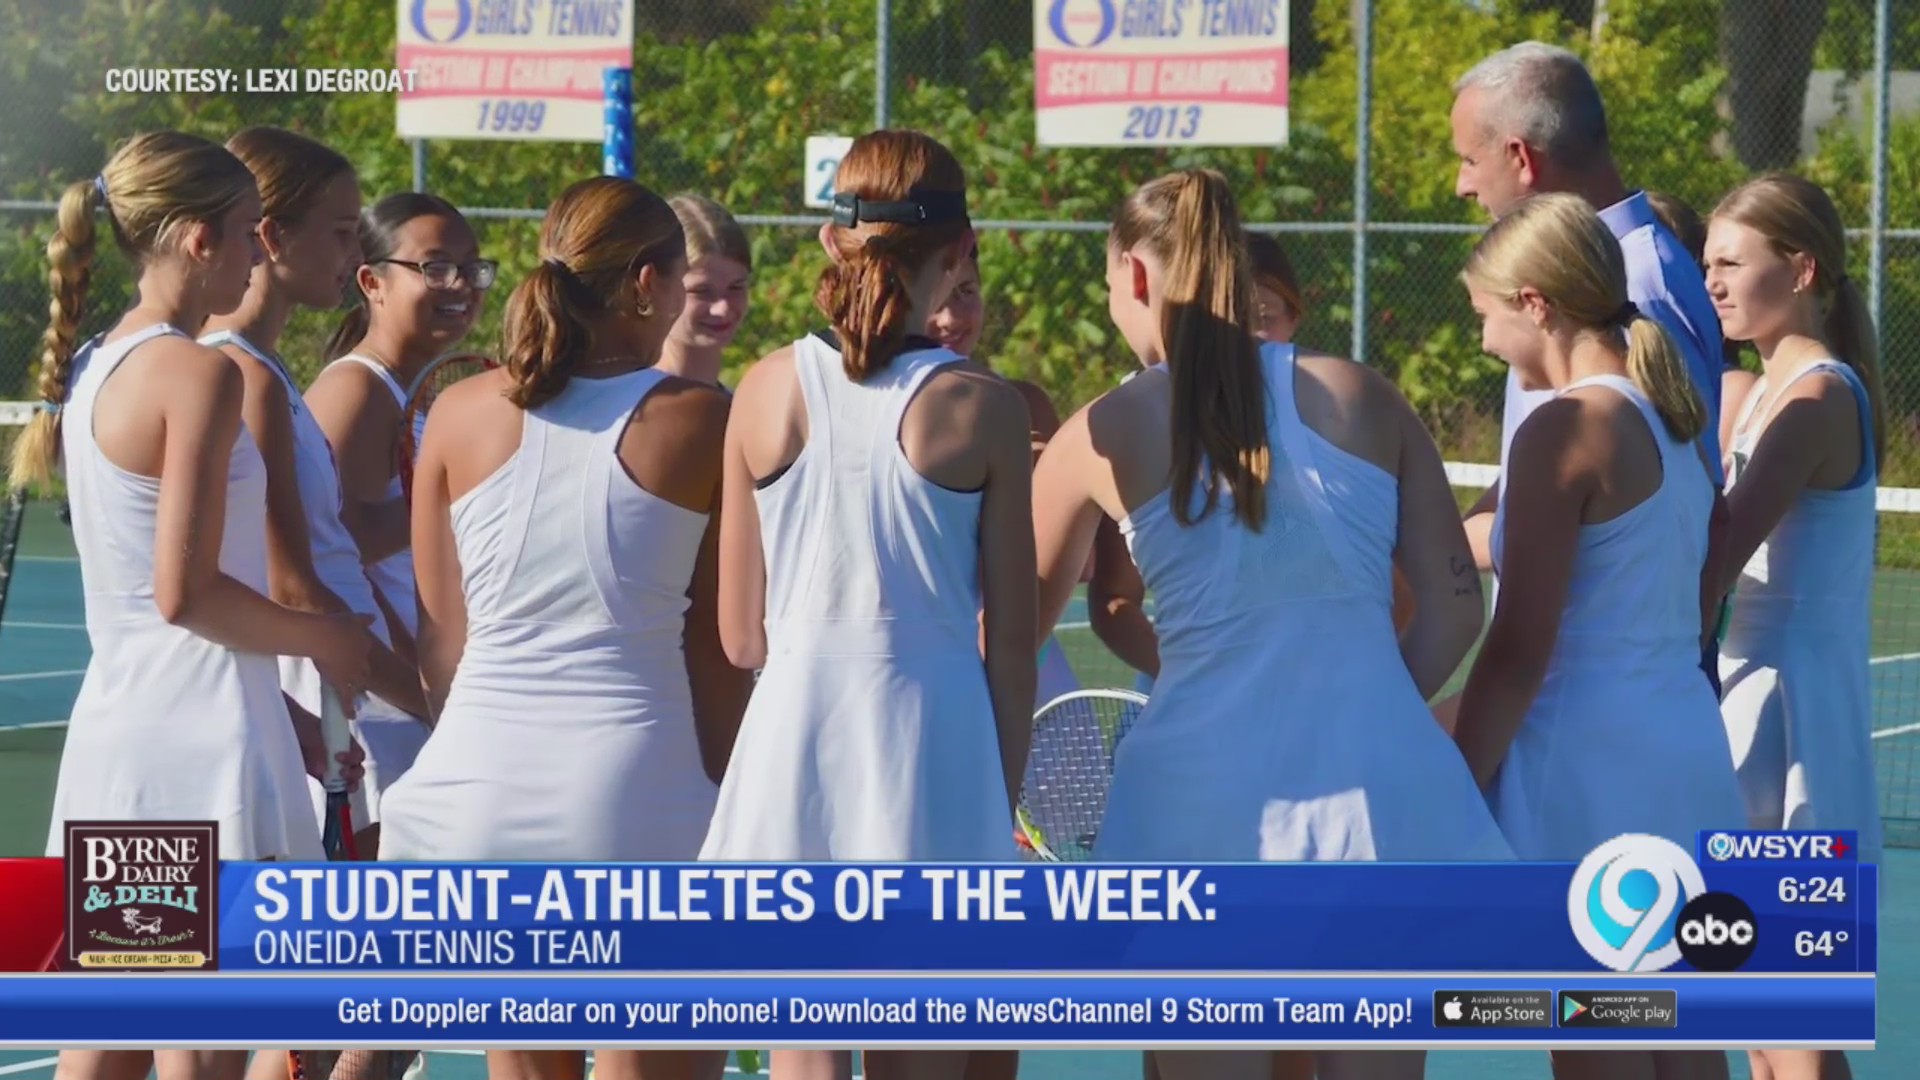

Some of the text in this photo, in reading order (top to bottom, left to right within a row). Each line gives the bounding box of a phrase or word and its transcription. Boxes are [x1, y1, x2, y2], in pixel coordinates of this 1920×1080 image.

[547, 0, 624, 36] TENNIS
[1199, 0, 1278, 37] TENNIS
[1047, 60, 1130, 97] SECTION
[1157, 59, 1276, 95] CHAMPIONS
[476, 101, 547, 132] 1999
[1123, 105, 1202, 139] 2013
[815, 159, 838, 201] 2
